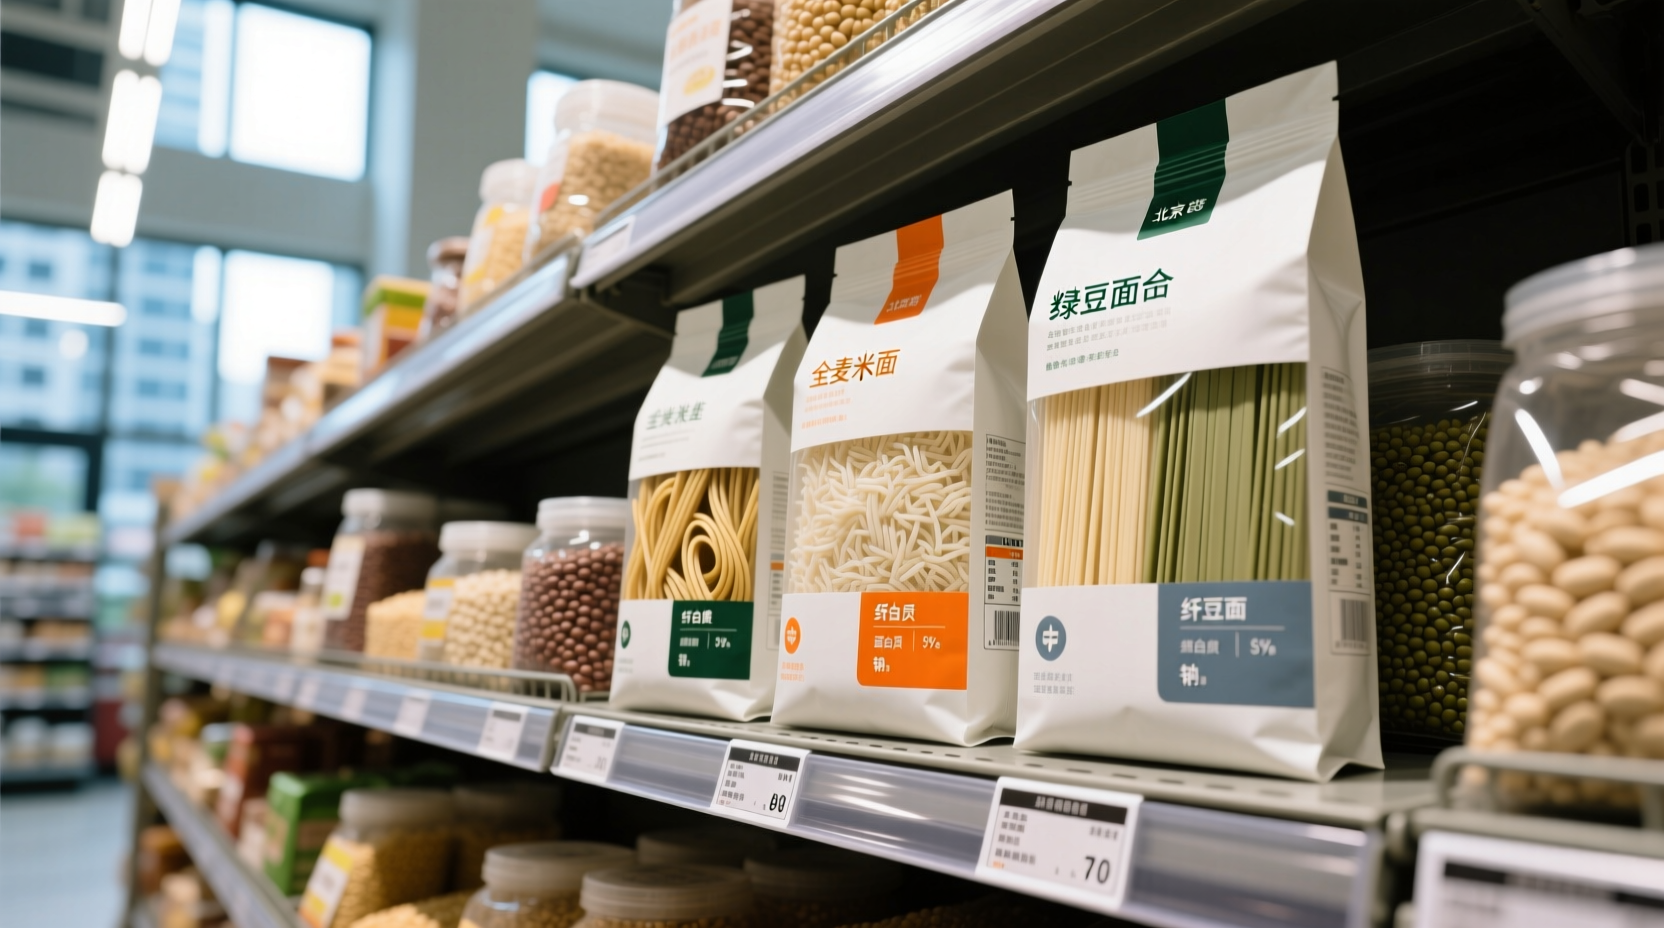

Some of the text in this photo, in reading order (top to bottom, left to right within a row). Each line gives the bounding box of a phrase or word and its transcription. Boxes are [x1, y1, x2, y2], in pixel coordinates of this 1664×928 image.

[809, 349, 901, 388] 全麦米面
[1084, 855, 1111, 884] 70
